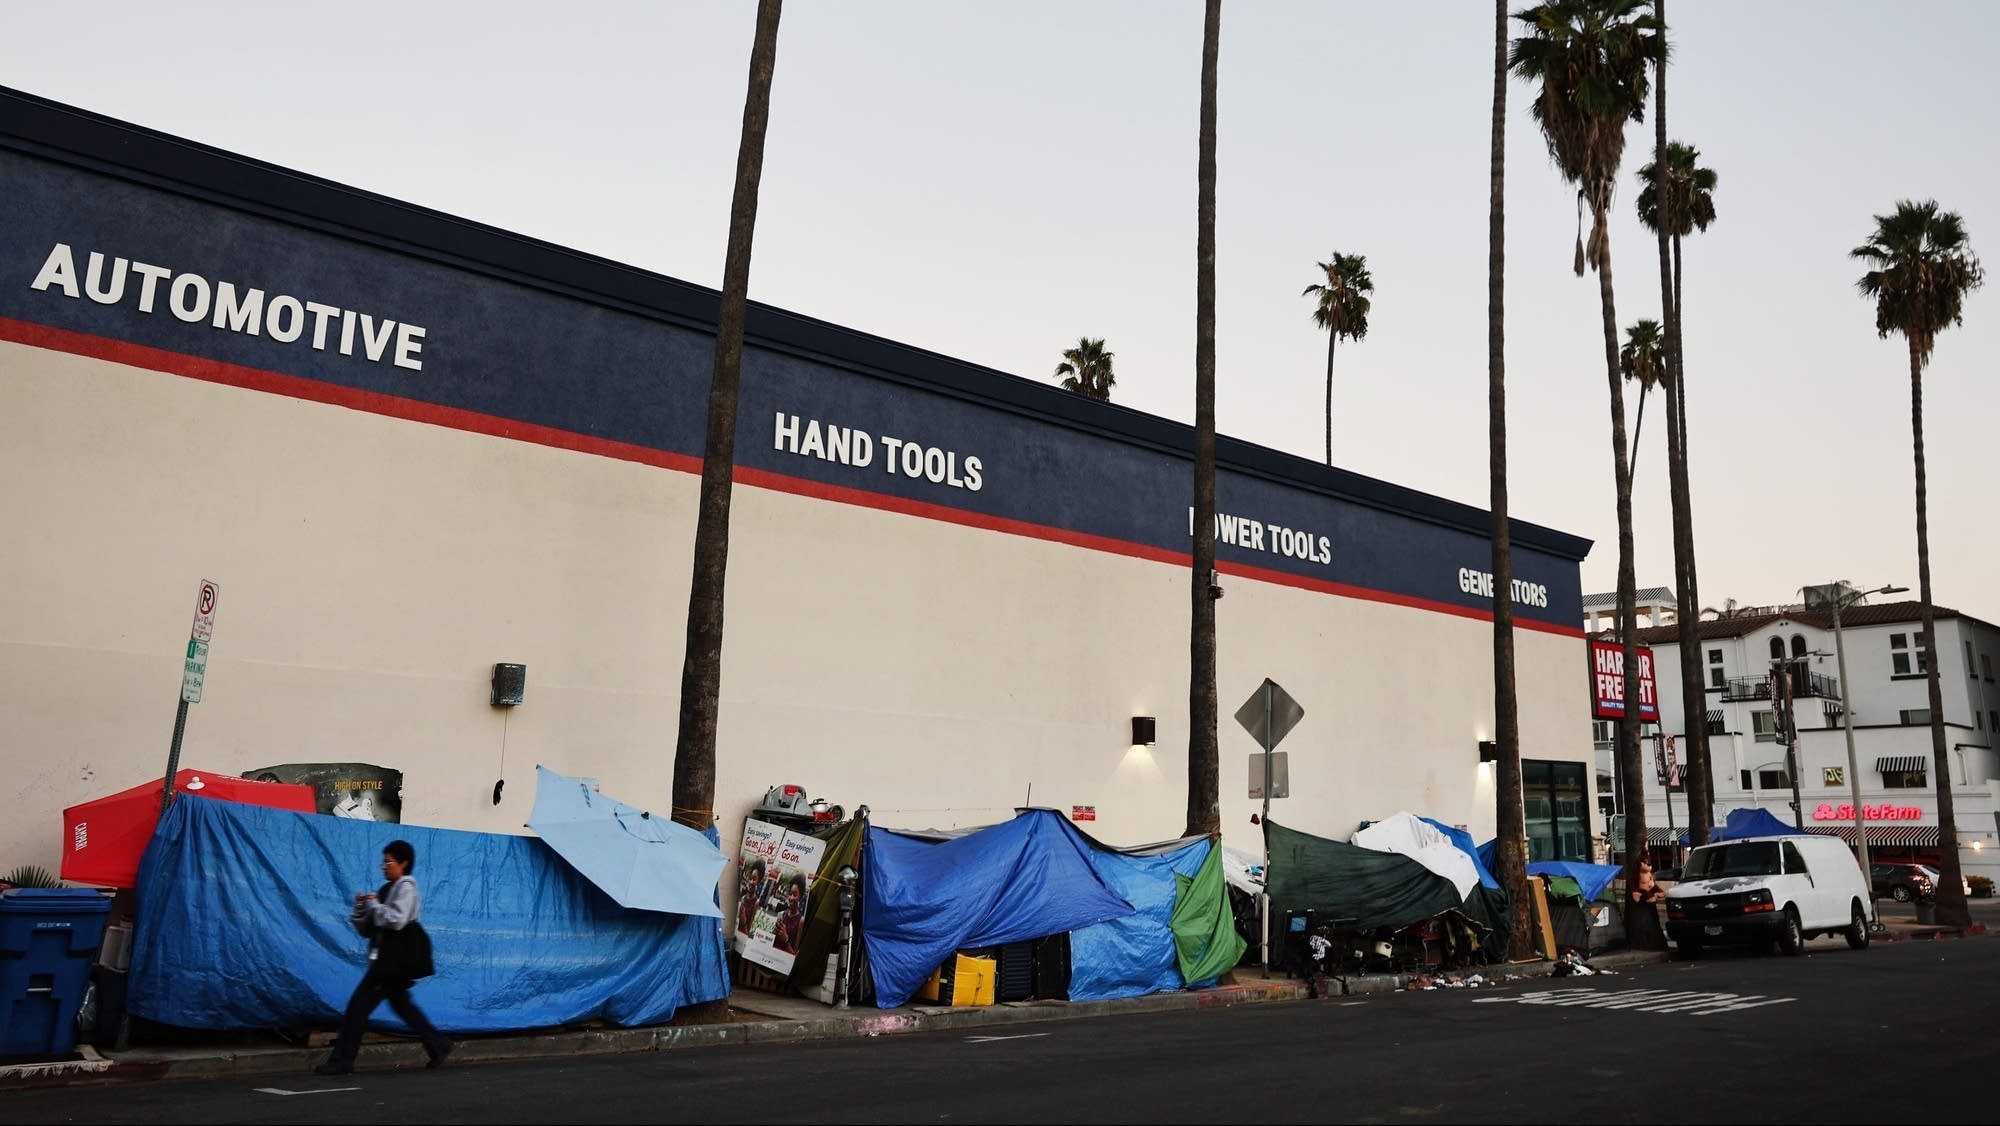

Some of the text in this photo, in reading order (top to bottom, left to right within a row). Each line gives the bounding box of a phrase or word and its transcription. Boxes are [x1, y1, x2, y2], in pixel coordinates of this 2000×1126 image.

[31, 243, 427, 371] AUTOMOTIVE
[774, 412, 983, 491] HAND TOOLS
[1189, 506, 1331, 565] WER TOOLS
[1459, 567, 1547, 608] GENETORS
[1596, 648, 1652, 679] HARR
[335, 781, 383, 791] HIGH ON STYLE
[745, 836, 753, 847] Go
[781, 849, 800, 863] Go on.
[786, 839, 796, 850] Easy
[796, 844, 814, 855] savings?
